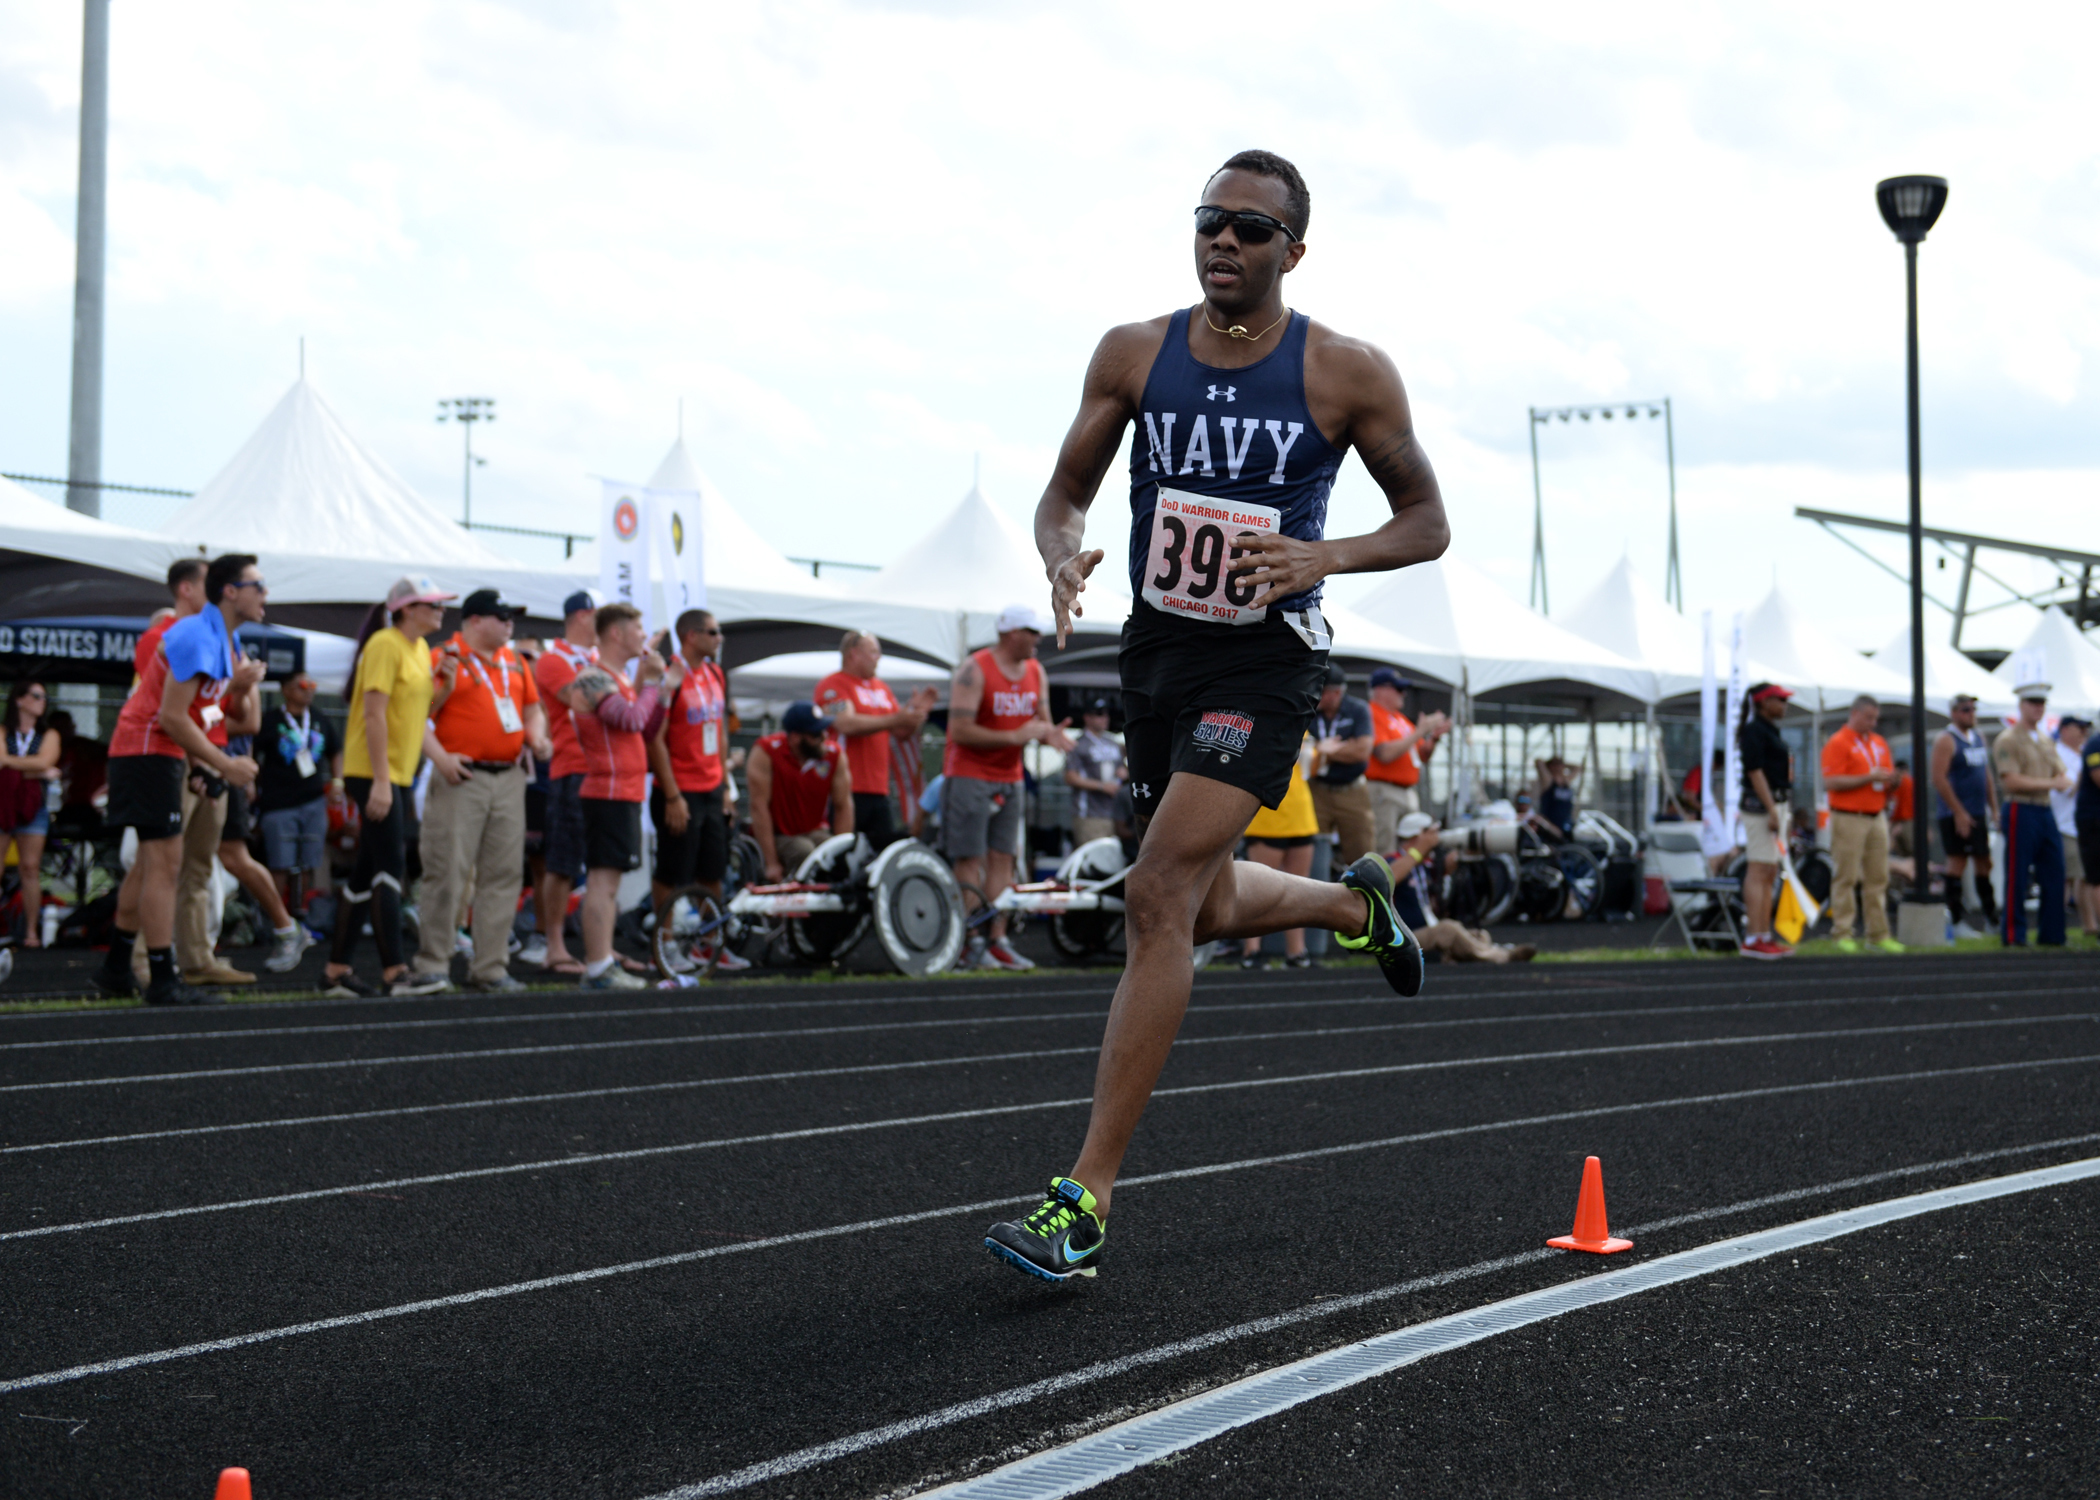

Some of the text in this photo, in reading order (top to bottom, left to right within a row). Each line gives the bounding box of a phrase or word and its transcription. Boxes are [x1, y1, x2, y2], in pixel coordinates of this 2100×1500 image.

[1144, 411, 1304, 485] NAVY
[1161, 498, 1179, 511] DoD
[1181, 502, 1230, 521] WARRIOR
[1232, 512, 1271, 528] GAMES
[618, 561, 633, 602] AM
[1162, 595, 1239, 620] CHICAGO 2017
[20, 627, 98, 659] STATES
[103, 631, 139, 662] MA
[993, 691, 1037, 716] USMC
[1193, 722, 1249, 747] GAMES
[1201, 711, 1254, 735] WARRIOR
[1060, 1183, 1080, 1196] NIKE
